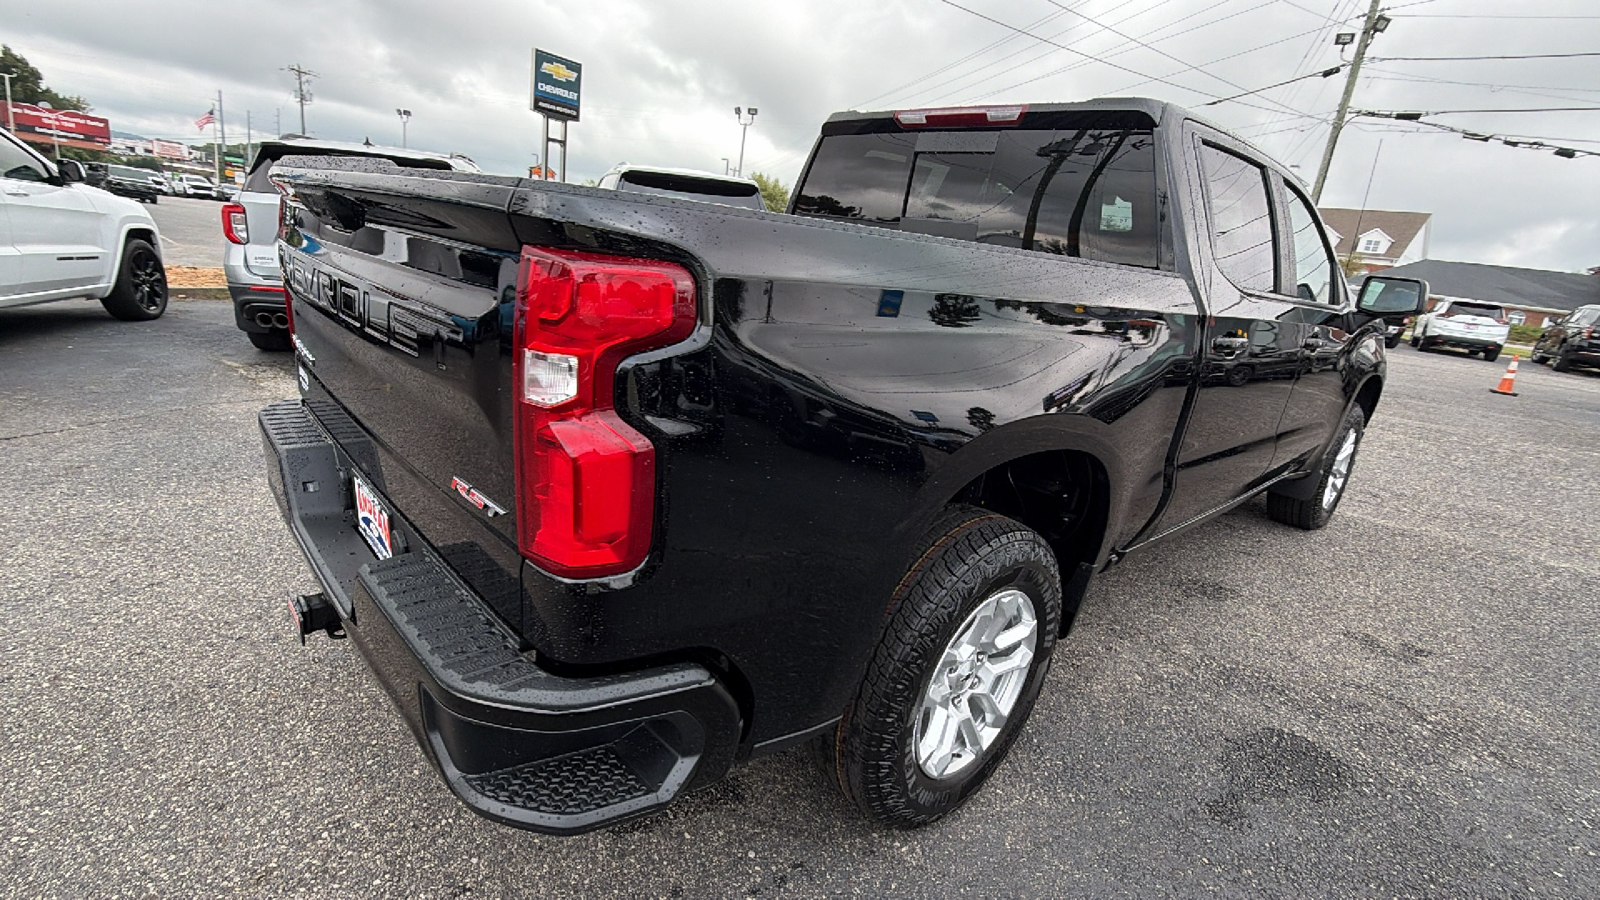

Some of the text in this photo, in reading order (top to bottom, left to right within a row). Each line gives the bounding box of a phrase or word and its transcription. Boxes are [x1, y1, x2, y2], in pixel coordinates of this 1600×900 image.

[538, 82, 578, 100] CHEVROLET
[279, 244, 463, 371] CHEVROLET
[451, 476, 508, 517] RST
